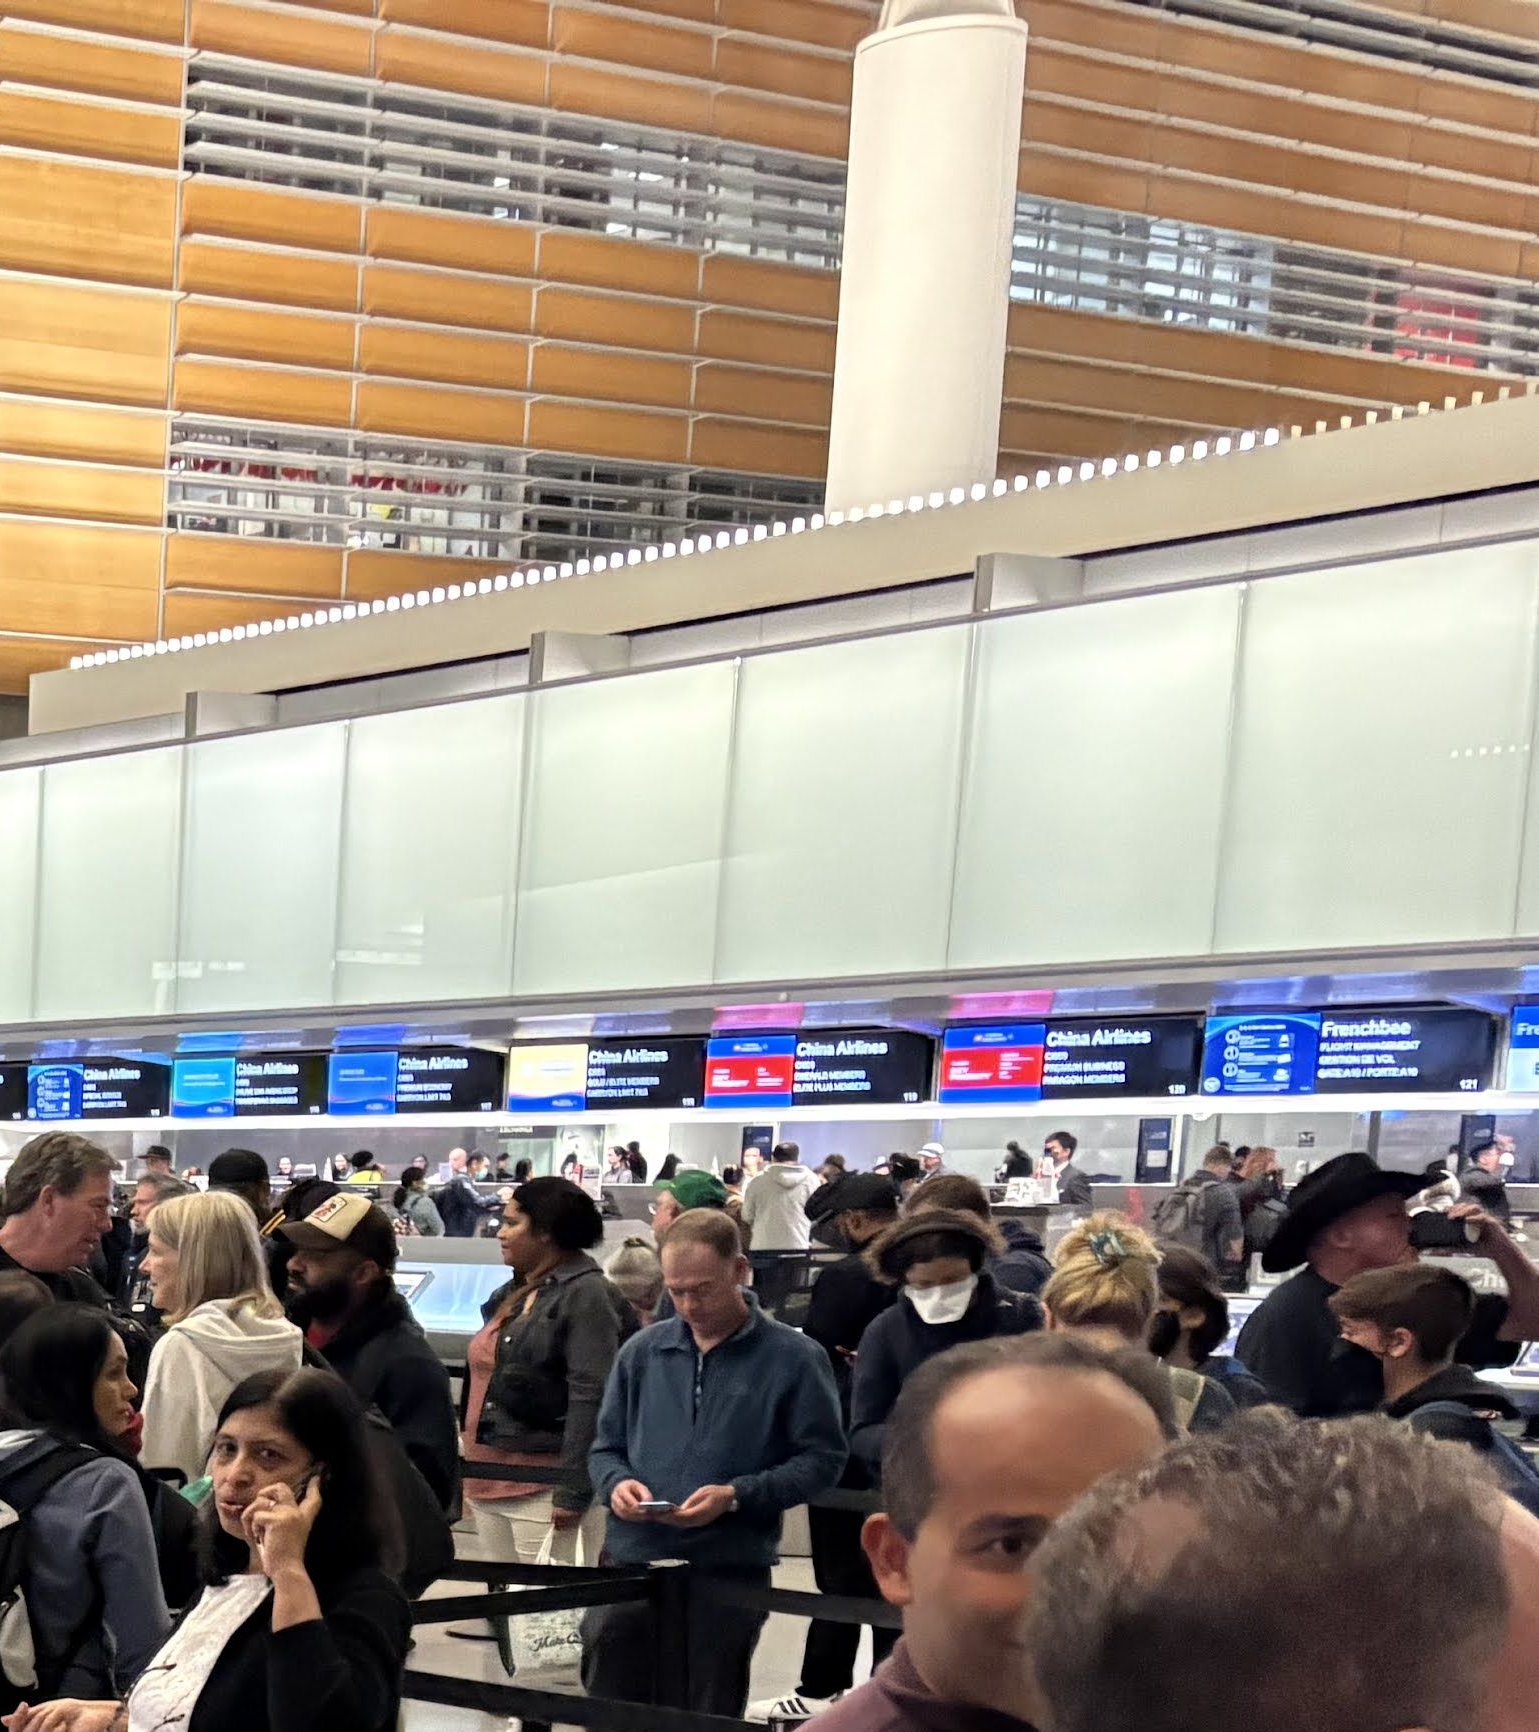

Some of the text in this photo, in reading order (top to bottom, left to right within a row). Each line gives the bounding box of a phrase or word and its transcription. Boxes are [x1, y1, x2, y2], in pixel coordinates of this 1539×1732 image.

[1046, 1027, 1152, 1047] China Airlines
[1321, 1020, 1412, 1038] Frenchbee
[589, 1048, 669, 1064] China Airlines
[796, 1039, 888, 1057] China Airlines
[398, 1056, 469, 1070] China Airlines
